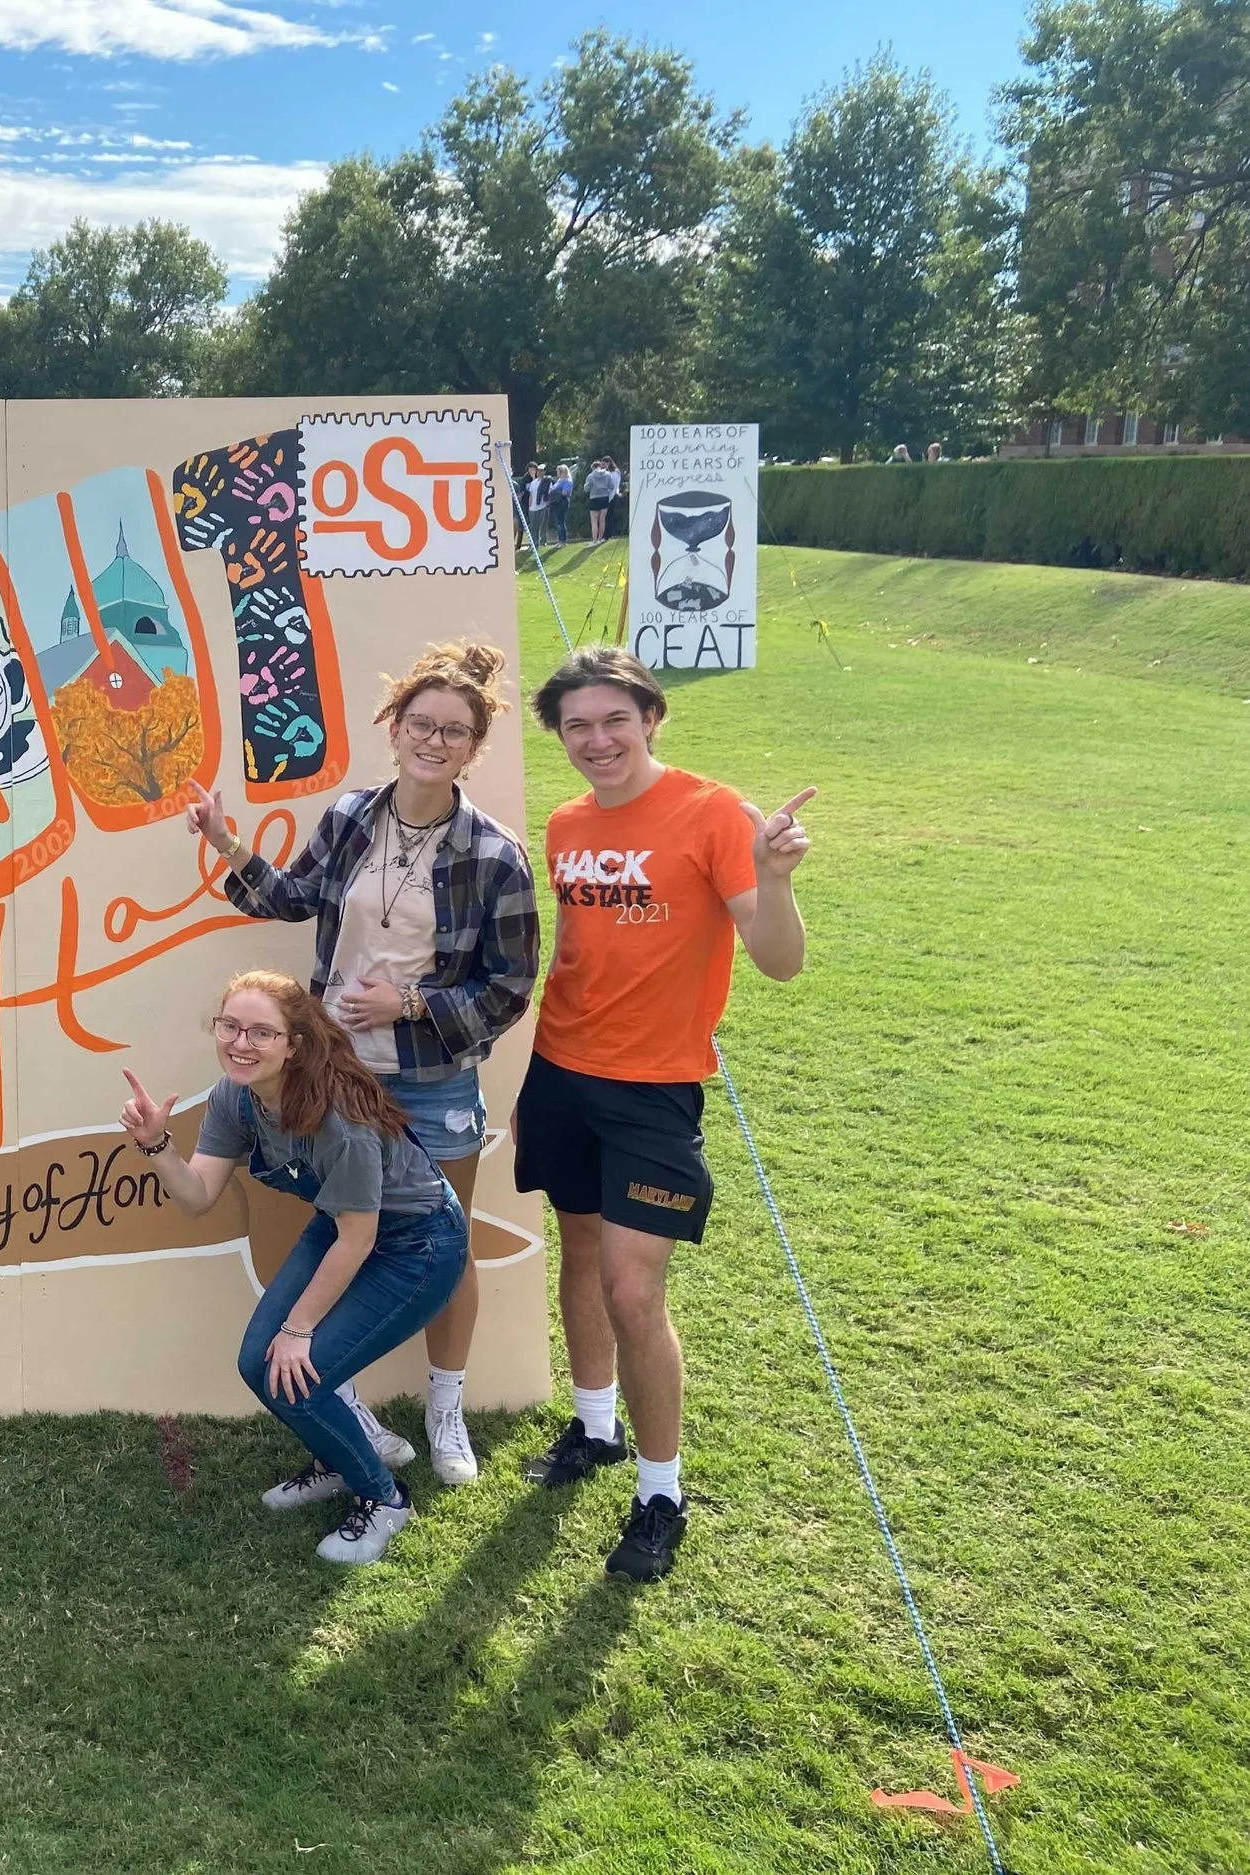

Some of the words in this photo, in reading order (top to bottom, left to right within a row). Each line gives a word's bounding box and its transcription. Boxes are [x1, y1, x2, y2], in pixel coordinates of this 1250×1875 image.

[640, 427, 667, 440] 100
[672, 426, 722, 440] YEARS
[727, 425, 750, 439] OF
[646, 441, 739, 457] Learning
[639, 458, 665, 471] 100
[671, 457, 724, 471] YEARS
[727, 456, 746, 470] OF
[644, 472, 727, 490] Progress
[311, 435, 484, 562] OSU
[640, 611, 663, 624] 100
[670, 610, 719, 624] YEARS
[726, 609, 748, 623] OF
[635, 623, 756, 669] CEAT
[291, 759, 344, 799] 2021
[13, 818, 74, 881] 2003
[554, 849, 655, 885] HACK
[579, 884, 653, 908] STATE
[615, 902, 669, 925] 2021
[22, 1162, 66, 1244] of
[57, 1144, 171, 1232] Hon
